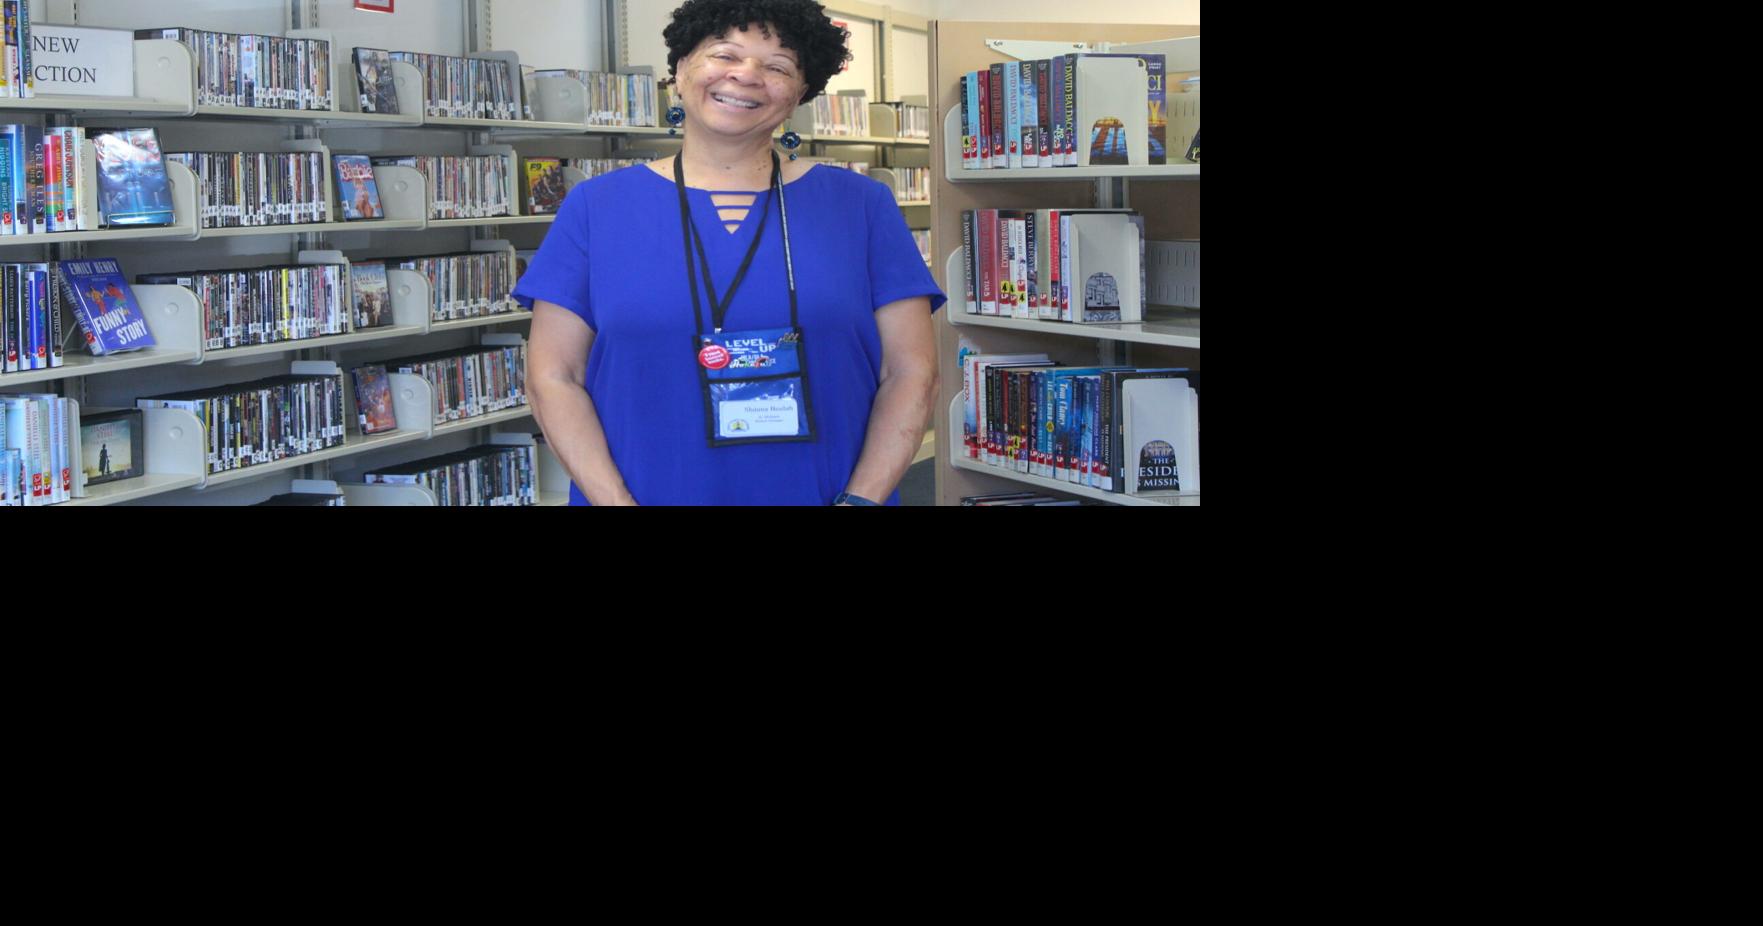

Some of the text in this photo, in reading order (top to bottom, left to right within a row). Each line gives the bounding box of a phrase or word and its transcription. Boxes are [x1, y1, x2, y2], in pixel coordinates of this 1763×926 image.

[33, 36, 80, 53] NEW
[34, 65, 96, 83] CTION
[1023, 64, 1031, 86] DAVID
[1065, 94, 1073, 133] BALDACC
[34, 143, 43, 179] GREG
[65, 154, 73, 188] JOHNSON
[963, 222, 971, 244] DAVID
[68, 262, 93, 275] EMILY
[93, 307, 127, 335] FUNNY
[116, 319, 148, 345] STORY
[725, 338, 764, 348] LEVEL
[759, 344, 776, 353] UP
[1058, 383, 1068, 425] Tom Clancy
[1132, 467, 1179, 477] ESIDE
[1144, 478, 1179, 487] MISSIN
